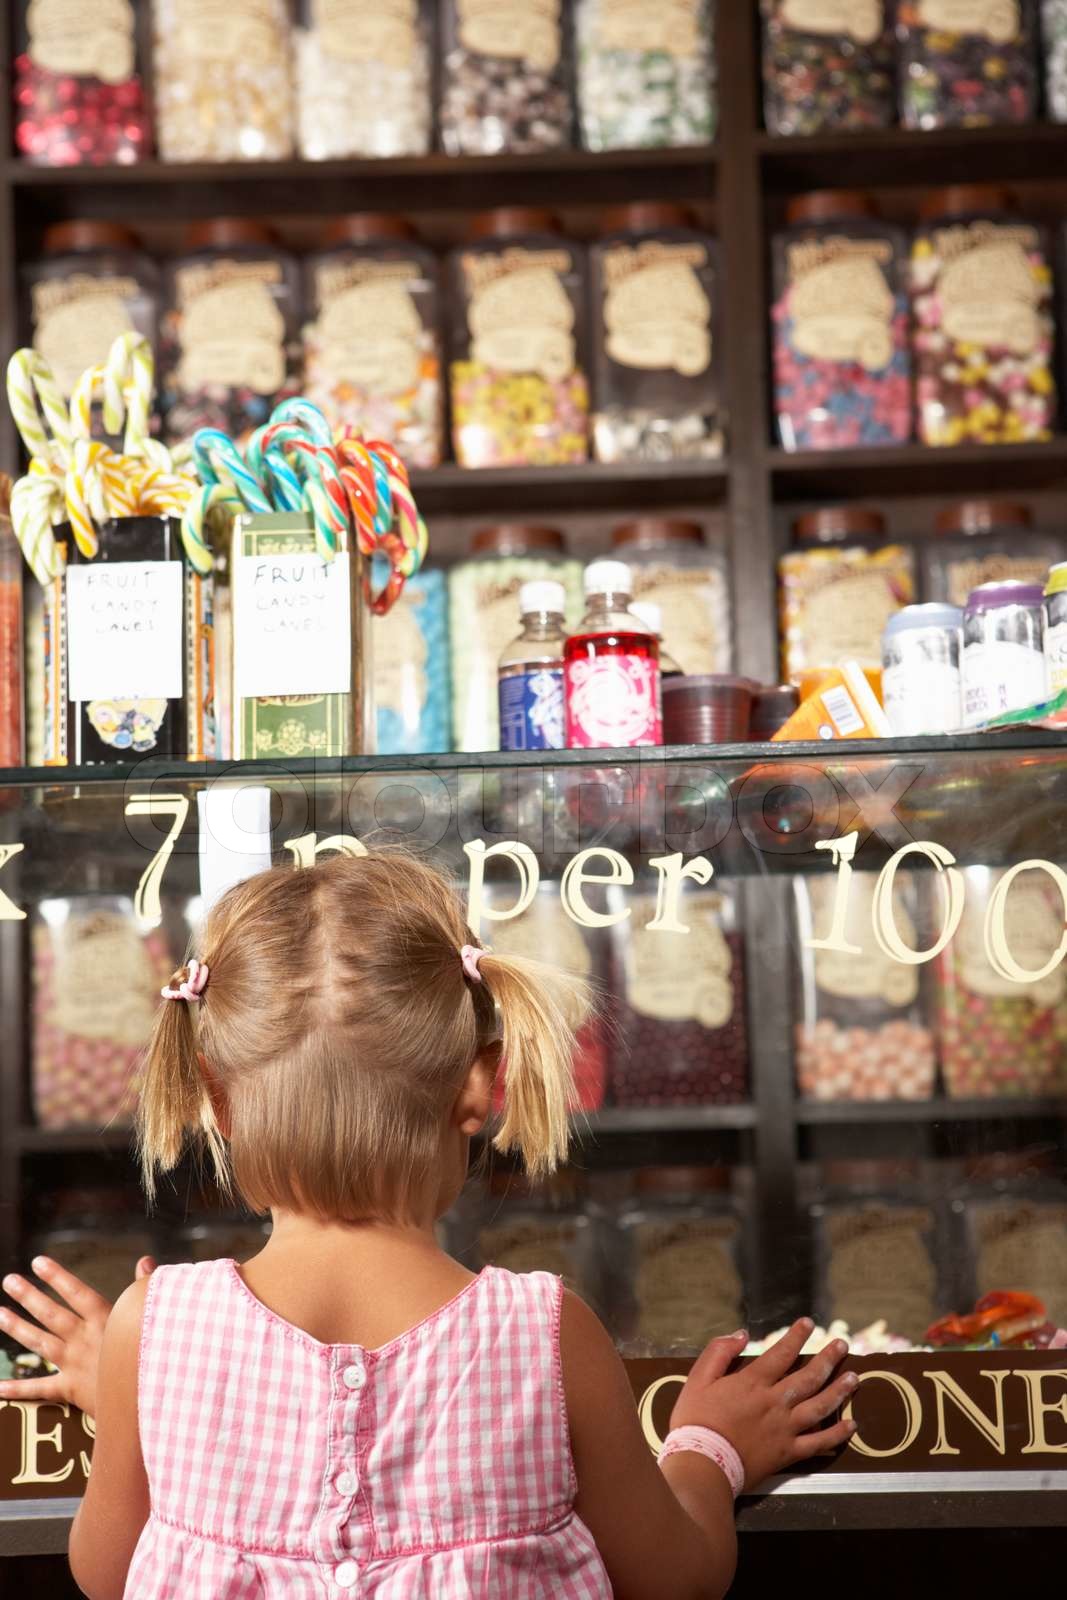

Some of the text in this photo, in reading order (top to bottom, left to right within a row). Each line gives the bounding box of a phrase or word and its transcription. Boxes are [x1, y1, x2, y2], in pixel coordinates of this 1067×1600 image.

[86, 570, 157, 588] FRUIT
[253, 560, 336, 585] FRUIT
[463, 838, 714, 939] per
